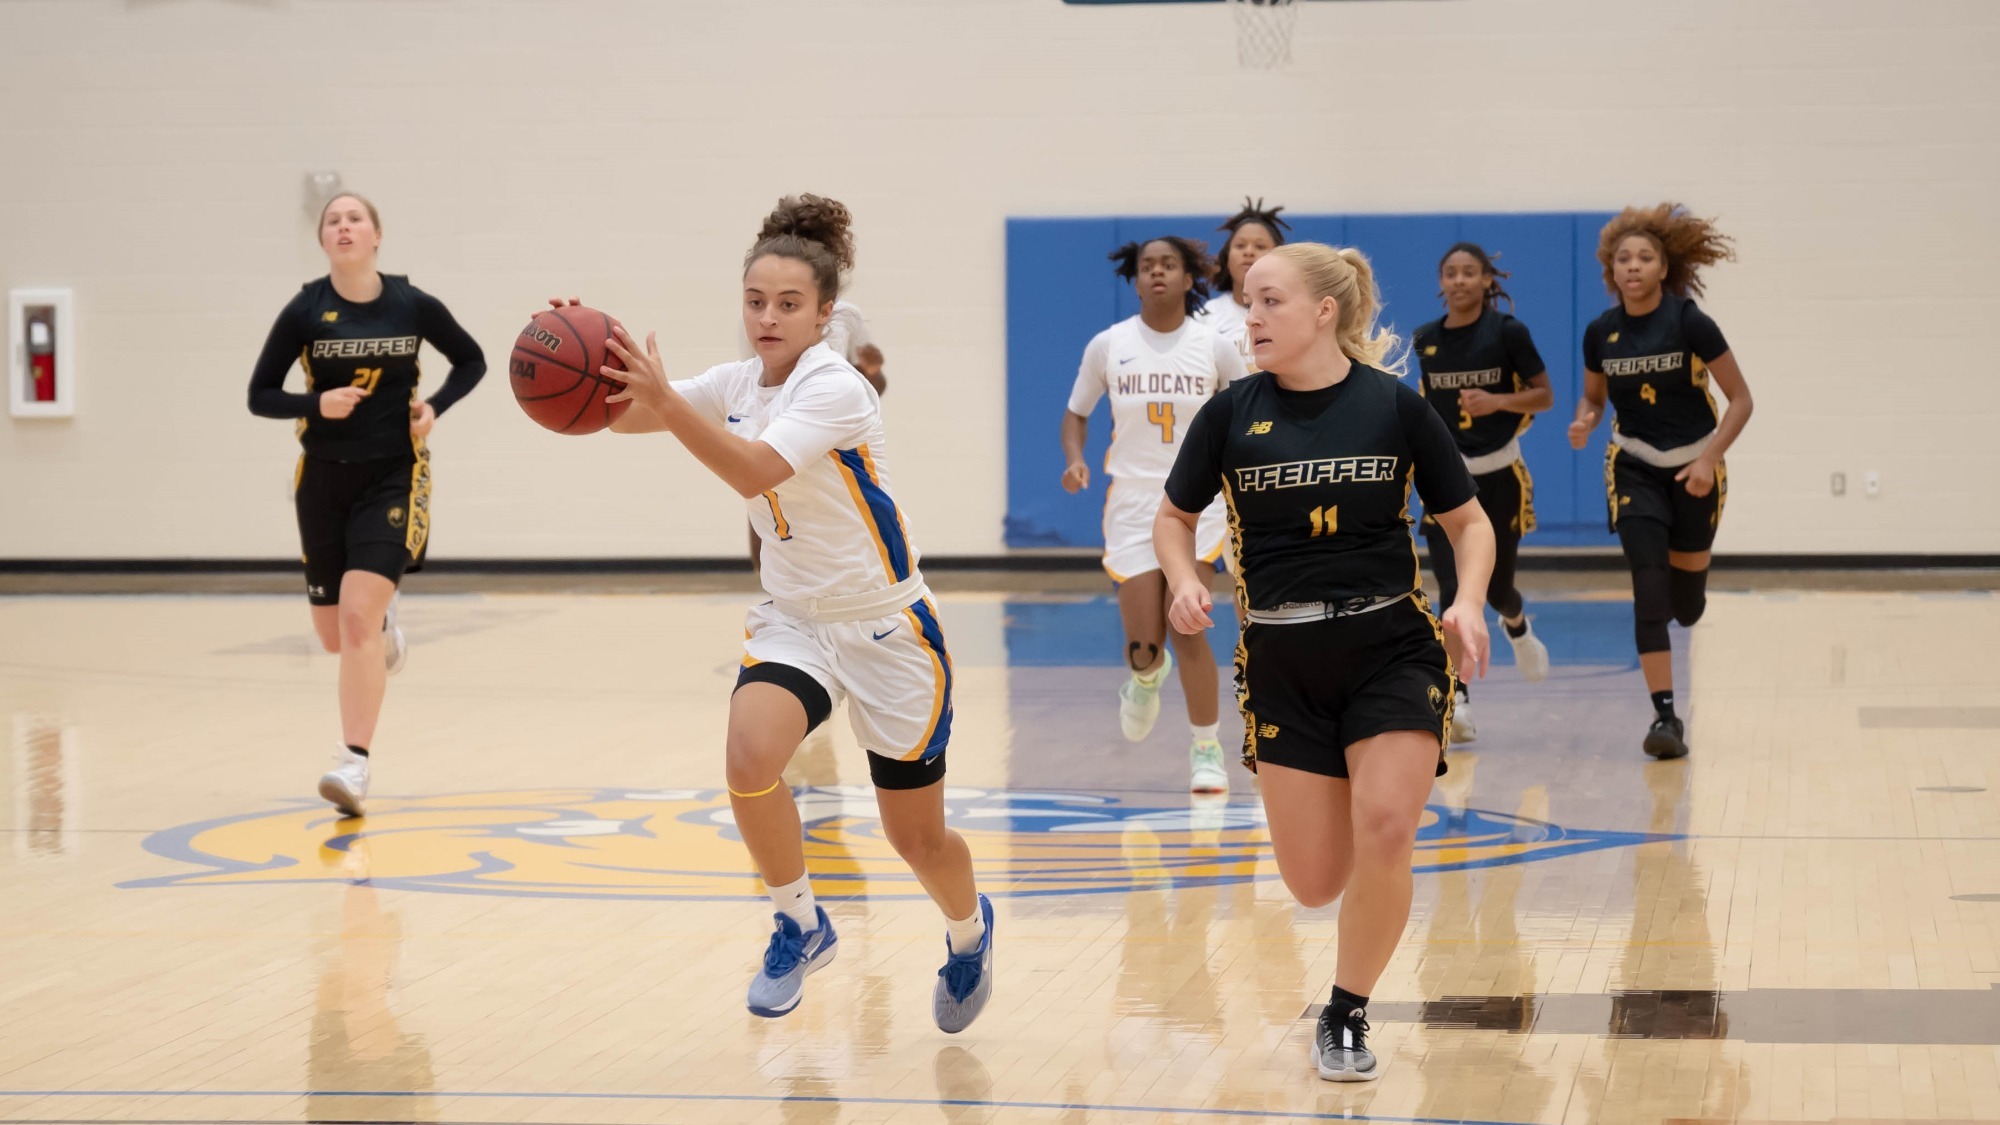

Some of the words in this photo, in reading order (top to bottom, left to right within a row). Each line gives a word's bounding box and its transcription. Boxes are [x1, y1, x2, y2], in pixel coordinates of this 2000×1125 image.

[312, 336, 417, 357] PFEIFFER
[350, 367, 383, 395] 21
[1118, 373, 1204, 396] WILDCATS
[1147, 402, 1176, 444] 4
[1235, 456, 1398, 492] PFEIFFER
[1309, 504, 1338, 538] 11
